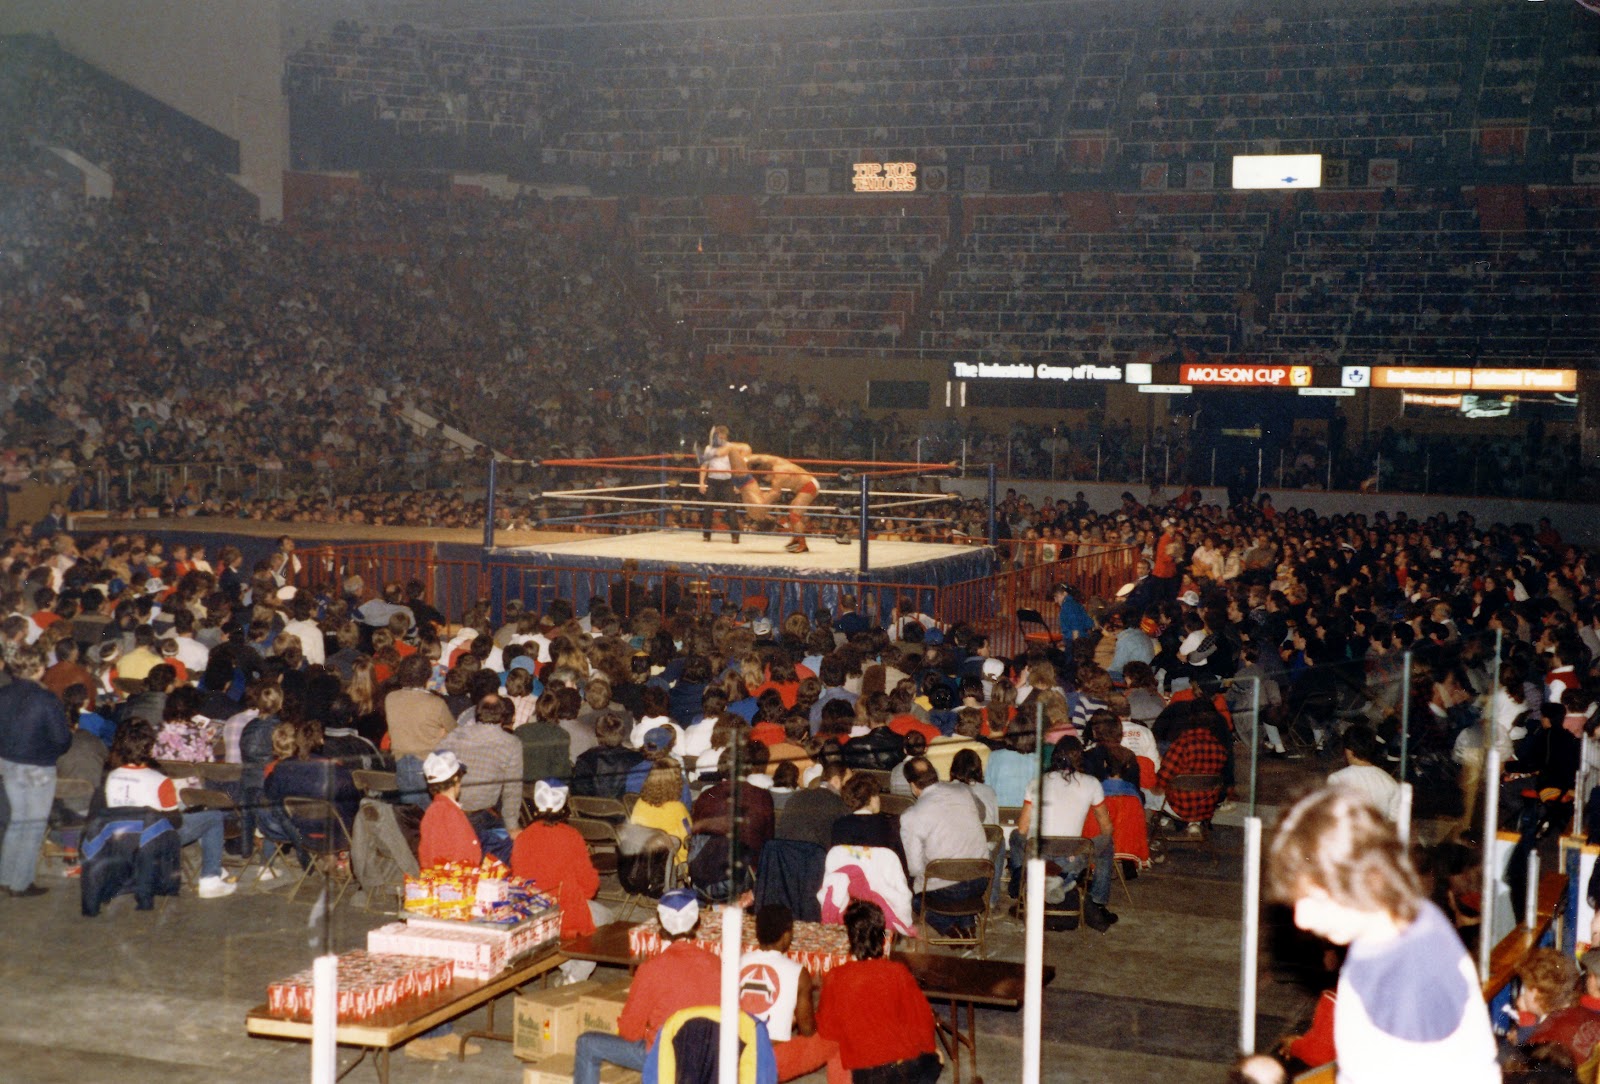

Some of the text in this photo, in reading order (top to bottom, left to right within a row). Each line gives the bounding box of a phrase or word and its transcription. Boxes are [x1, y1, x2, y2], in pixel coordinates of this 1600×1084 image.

[853, 162, 917, 177] TIP TOP
[852, 176, 917, 192] TAILORS
[953, 362, 978, 377] The
[1187, 367, 1286, 384] MOLSON CUP
